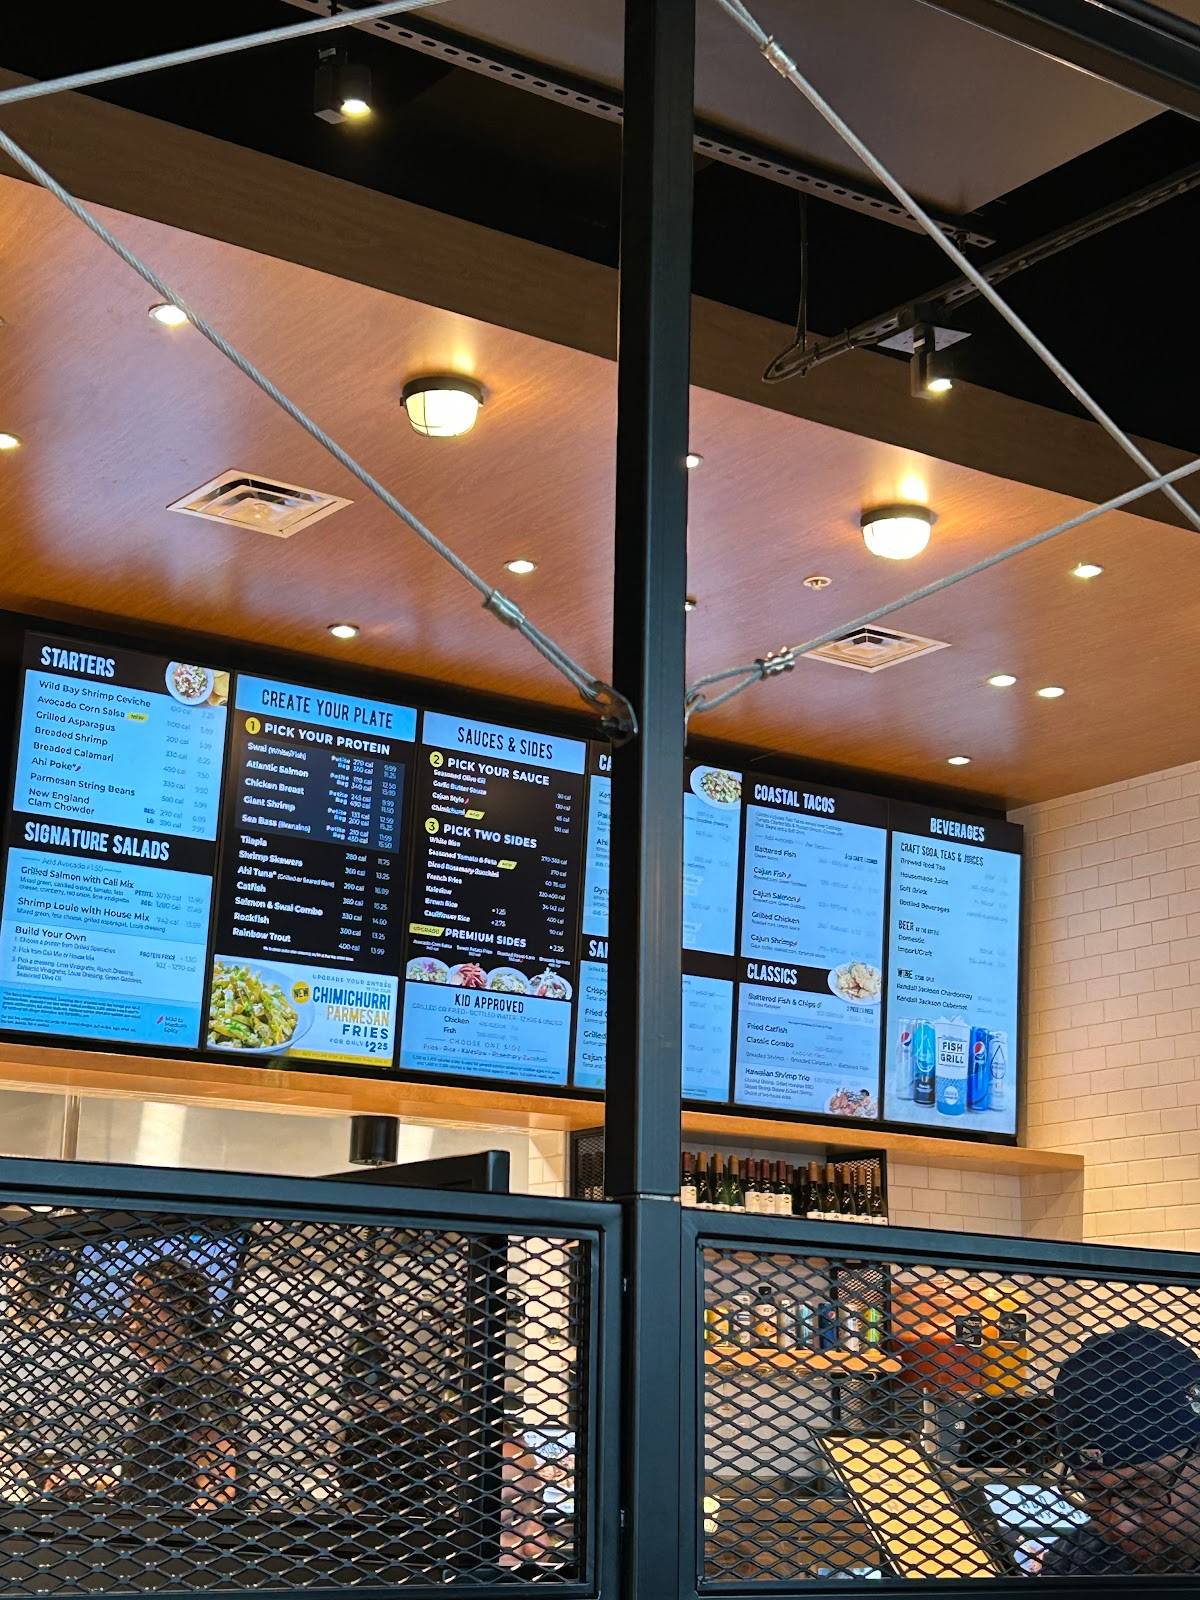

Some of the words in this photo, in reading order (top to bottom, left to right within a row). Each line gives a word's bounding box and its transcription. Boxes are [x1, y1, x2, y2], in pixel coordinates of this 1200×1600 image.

[40, 646, 116, 678] STARTERS
[39, 680, 61, 691] Wild
[63, 684, 80, 696] Bay
[82, 688, 114, 702] Shrimp
[117, 694, 151, 707] Ceviche
[38, 696, 77, 709] Avocado
[80, 703, 100, 714] Corn
[103, 707, 125, 718] Salsa
[262, 689, 311, 713] CREATE
[316, 699, 349, 721] YOUR
[354, 707, 392, 729] PLATE
[36, 711, 65, 724] Grilled
[68, 716, 116, 732] Asparagus
[35, 727, 73, 740] Breaded
[75, 733, 108, 746] Shrimp
[264, 722, 295, 738] PICK
[298, 729, 333, 745] YOUR
[337, 736, 390, 755] PROTEIN
[457, 727, 504, 750] SAUCES
[508, 737, 516, 752] &
[520, 739, 553, 760] SIDES
[33, 742, 71, 755] Breaded
[74, 748, 114, 762] Calamari
[32, 757, 47, 766] Ahi
[246, 760, 278, 773] Atlantic
[279, 766, 309, 778] Salmon
[448, 757, 475, 772] PICK
[479, 763, 509, 778] YOUR
[513, 770, 550, 786] SAUCE
[30, 772, 76, 787] Parmesan
[78, 780, 105, 793] String
[108, 784, 135, 796] Beans
[245, 778, 278, 790] Chicken
[279, 784, 305, 795] Breast
[29, 788, 50, 798] New
[52, 791, 90, 805] England
[243, 796, 265, 806] Giant
[267, 800, 296, 812] Shrimp
[432, 792, 449, 802] Cajun
[450, 795, 464, 804] Style
[754, 784, 800, 807] COASTAL
[803, 793, 835, 813] TACOS
[27, 798, 51, 809] Clam
[54, 801, 94, 815] Chowder
[242, 814, 257, 823] Sea
[258, 817, 277, 827] Bass
[443, 824, 471, 838] PICK
[475, 829, 501, 843] TWO
[504, 835, 537, 849] SIDES
[930, 818, 985, 842] BEVERAGES
[24, 822, 109, 853] SIGNATURE
[113, 835, 170, 861] SALADS
[240, 835, 268, 847] Tilapia
[429, 836, 447, 846] White
[447, 839, 461, 847] Rice
[238, 850, 268, 863] Shrimp
[270, 854, 303, 867] Skewers
[428, 849, 456, 860] Seasoned
[901, 842, 919, 855] CRAFT
[940, 851, 956, 861] TEAS
[237, 866, 252, 875] Ahi
[427, 861, 445, 870] Diced
[753, 866, 772, 876] Cajun
[21, 866, 48, 876] Grilled
[50, 870, 80, 881] Salmon
[83, 875, 101, 884] with
[103, 878, 118, 886] Cali
[120, 880, 135, 888] Mix
[426, 873, 447, 882] French
[448, 876, 462, 884] Fries
[237, 881, 266, 893] Catfish
[752, 889, 771, 899] Cajun
[18, 897, 52, 910] Shrimp
[53, 902, 79, 913] Louie
[81, 906, 101, 916] with
[103, 908, 132, 919] House
[134, 912, 150, 921] Mix
[235, 896, 266, 909] Salmon
[267, 901, 273, 909] &
[274, 902, 293, 912] Swai
[295, 905, 323, 916] Combo
[425, 898, 444, 906] Brown
[445, 900, 458, 908] Rice
[234, 912, 269, 924] Rockfish
[458, 914, 470, 922] Rice
[774, 915, 800, 924] Chicken
[898, 920, 913, 931] BEER
[15, 926, 40, 936] Build
[42, 930, 63, 939] Your
[65, 932, 87, 942] Own
[232, 927, 268, 940] Rainbow
[269, 932, 291, 942] Trout
[445, 928, 494, 944] PREMIUM
[496, 935, 527, 948] SIDES
[751, 934, 769, 943] Cajun
[747, 963, 798, 985] CLASSICS
[313, 986, 391, 1010] CHIMICHURRI
[455, 994, 470, 1007] KID
[474, 996, 524, 1013] APPROVED
[327, 1005, 389, 1026] PARMESAN
[342, 1024, 388, 1039] FRIES
[747, 1023, 763, 1031] Fried
[765, 1025, 788, 1034] Catfish
[746, 1036, 770, 1045] Classic
[771, 1040, 794, 1048] Combo
[943, 1042, 962, 1051] FISH
[941, 1053, 963, 1064] GRILL
[745, 1068, 774, 1077] Hawaiian
